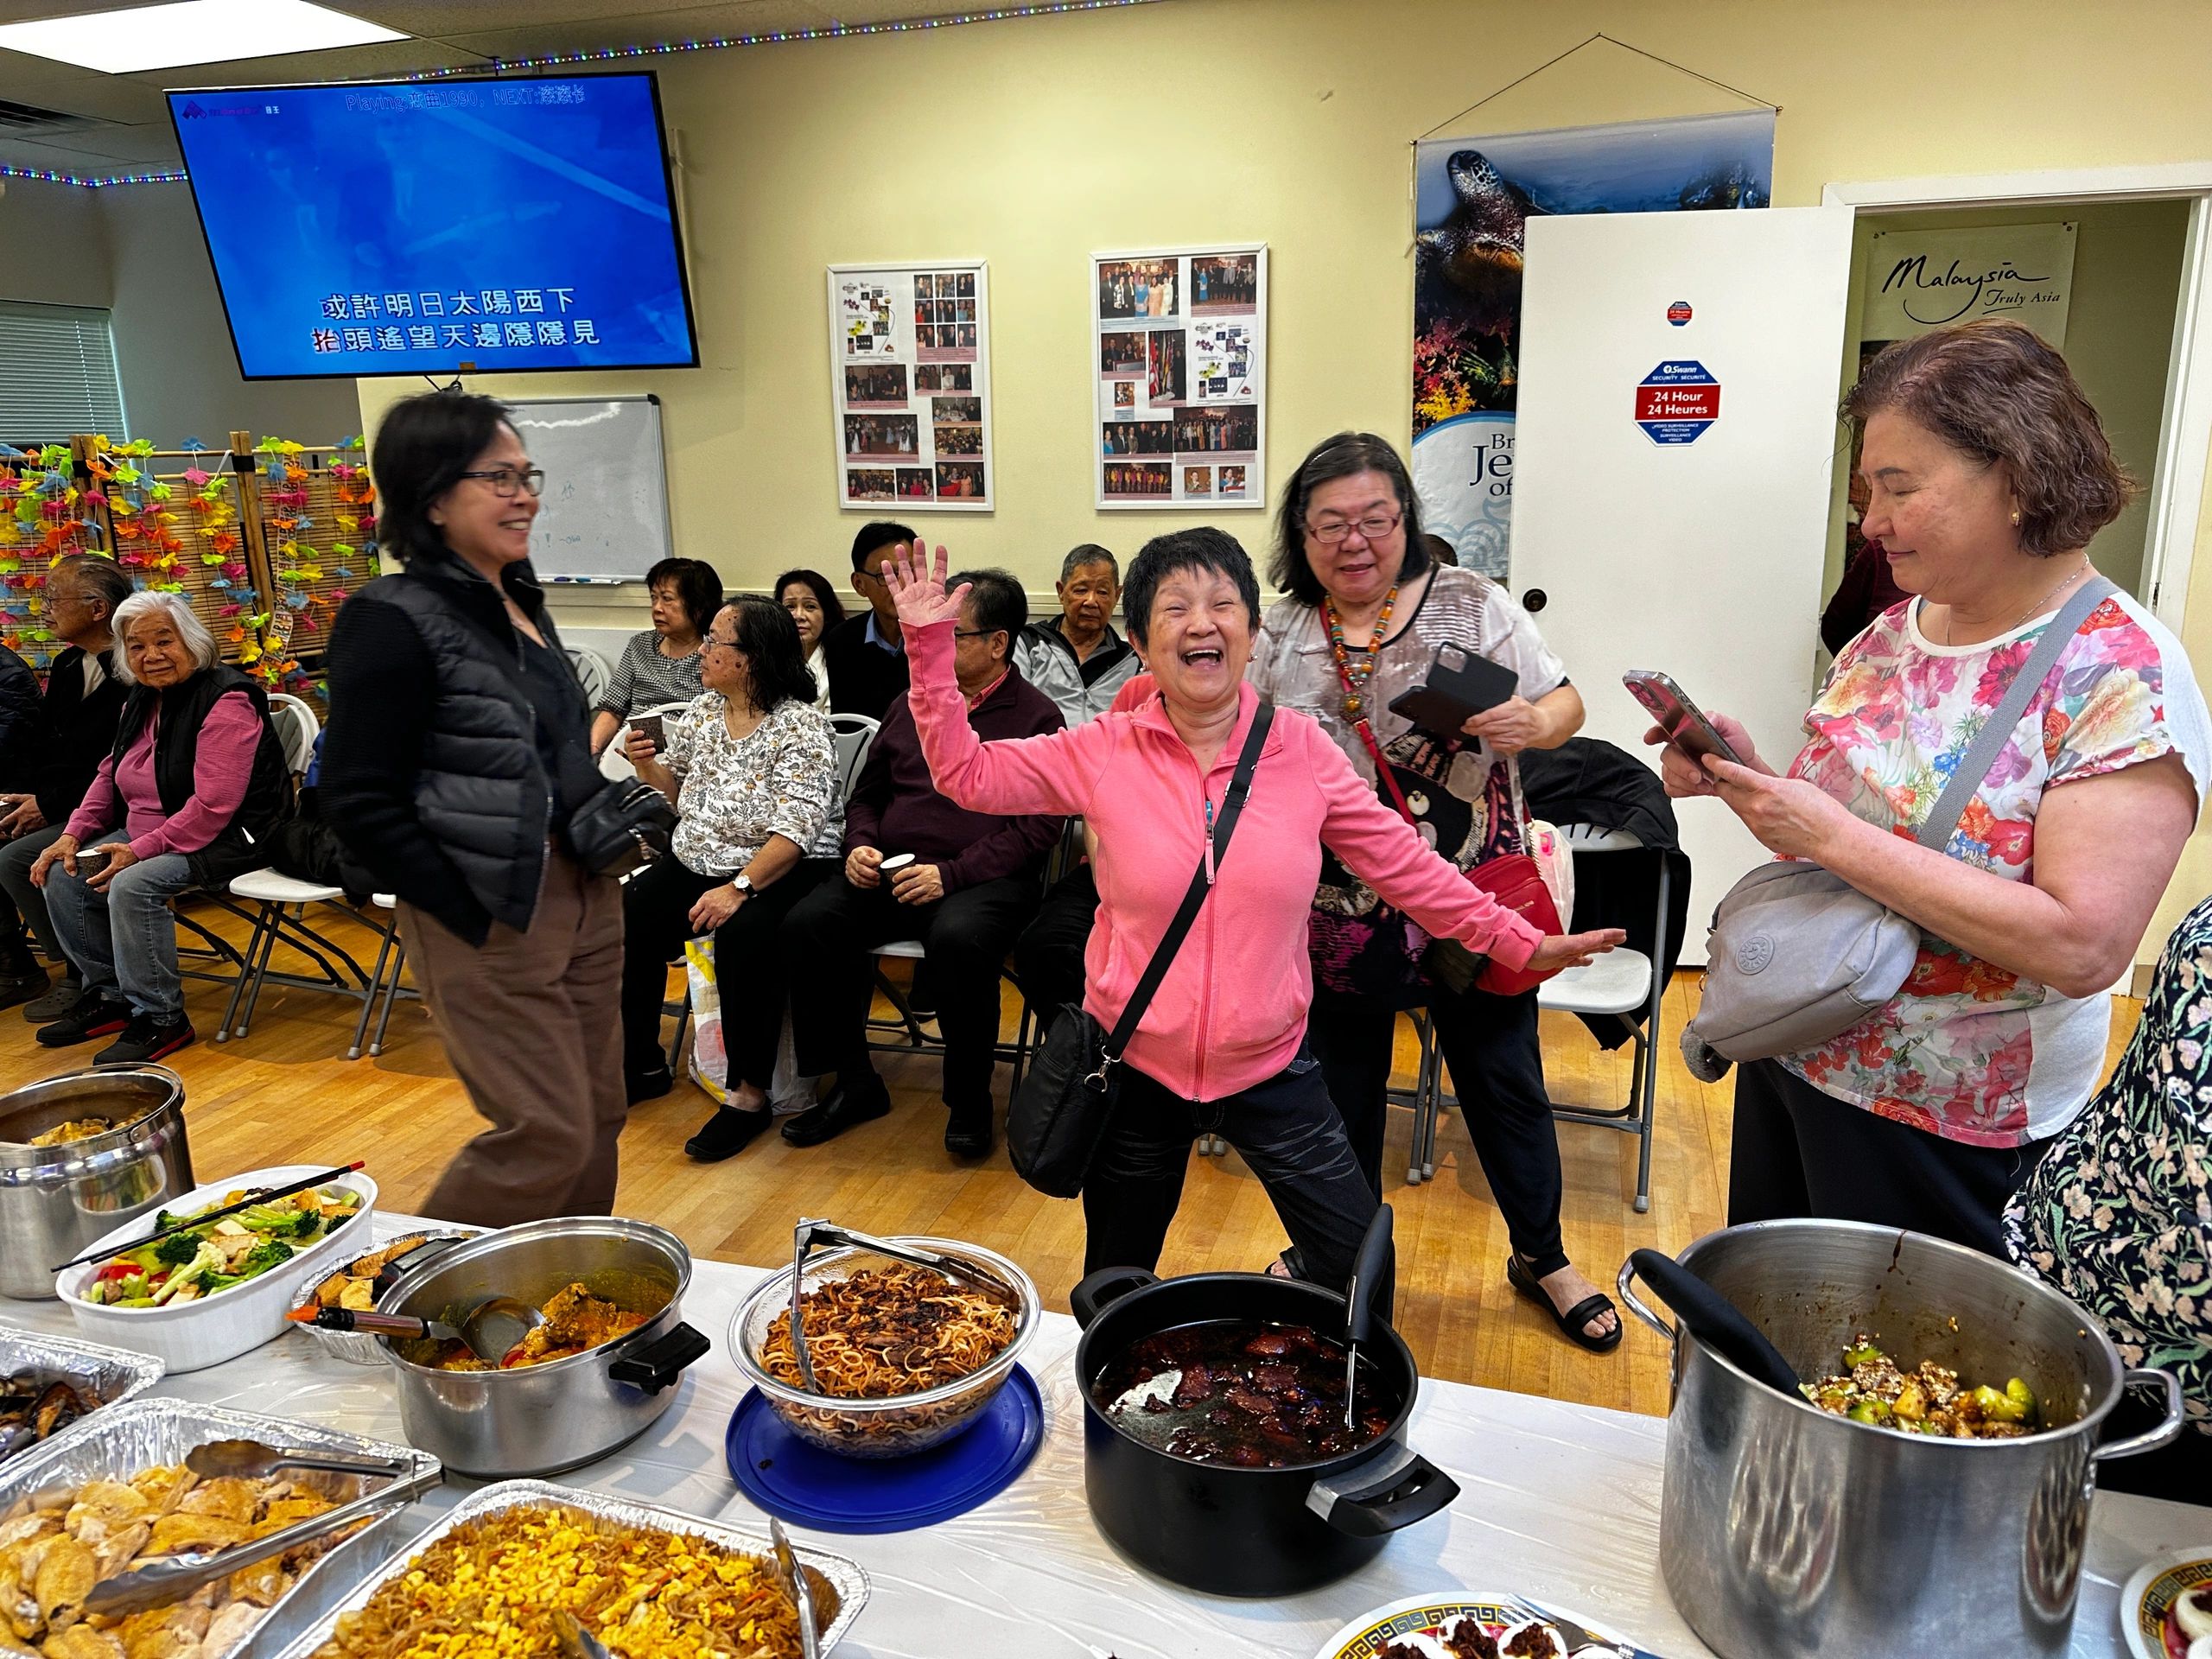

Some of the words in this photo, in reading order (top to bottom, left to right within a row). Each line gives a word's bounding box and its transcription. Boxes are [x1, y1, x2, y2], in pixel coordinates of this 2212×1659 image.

[1882, 255, 2051, 325] Malaysia
[1984, 289, 2026, 307] Truly
[2031, 291, 2061, 303] Asia
[321, 288, 575, 320] 或許明日太陽西下
[310, 320, 601, 353] 抬頭遙望天邊隱隱見
[1647, 404, 1662, 415] 24
[1665, 404, 1708, 415] Heures
[1654, 391, 1669, 402] 24
[1672, 391, 1703, 402] Hour
[1469, 445, 1515, 486] Je
[1490, 476, 1513, 497] of
